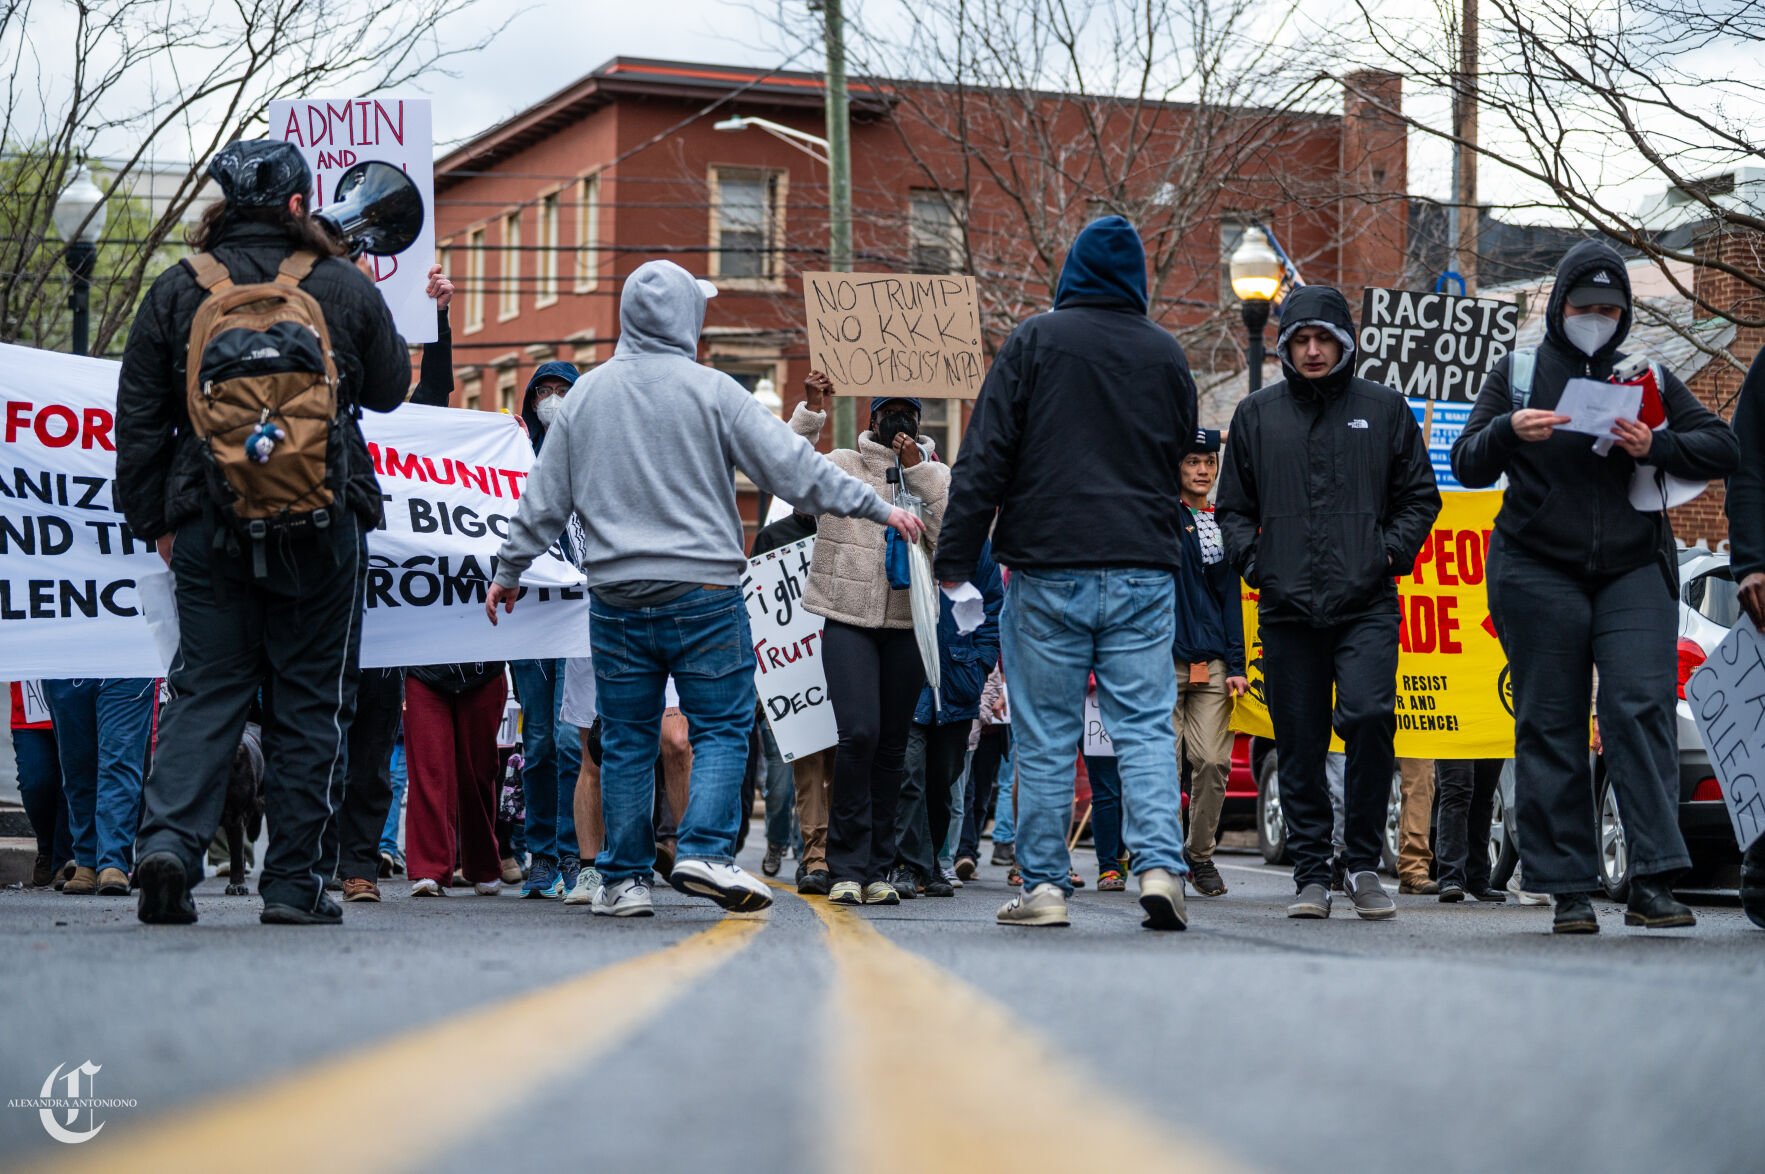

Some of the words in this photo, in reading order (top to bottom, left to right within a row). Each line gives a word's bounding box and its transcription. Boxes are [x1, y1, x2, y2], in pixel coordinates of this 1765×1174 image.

[284, 99, 404, 148] ADMIN
[317, 149, 357, 170] AND
[812, 279, 857, 314] NO
[856, 278, 971, 313] TRUMP!
[1371, 288, 1518, 342] RACISTS
[816, 315, 862, 346] NO
[879, 311, 978, 348] KKK!
[1359, 326, 1425, 363] OFF
[1434, 333, 1507, 372] OUR
[818, 347, 874, 386] NO
[5, 401, 118, 451] FOR
[368, 442, 529, 499] MUNIT
[0, 579, 146, 620] LENC
[753, 628, 824, 675] TRUT
[1403, 674, 1448, 691] RESIST
[1410, 695, 1436, 710] AND
[767, 686, 831, 722] DEC
[1396, 714, 1459, 731] IOLENCE!
[1690, 666, 1765, 844] COLLEGE
